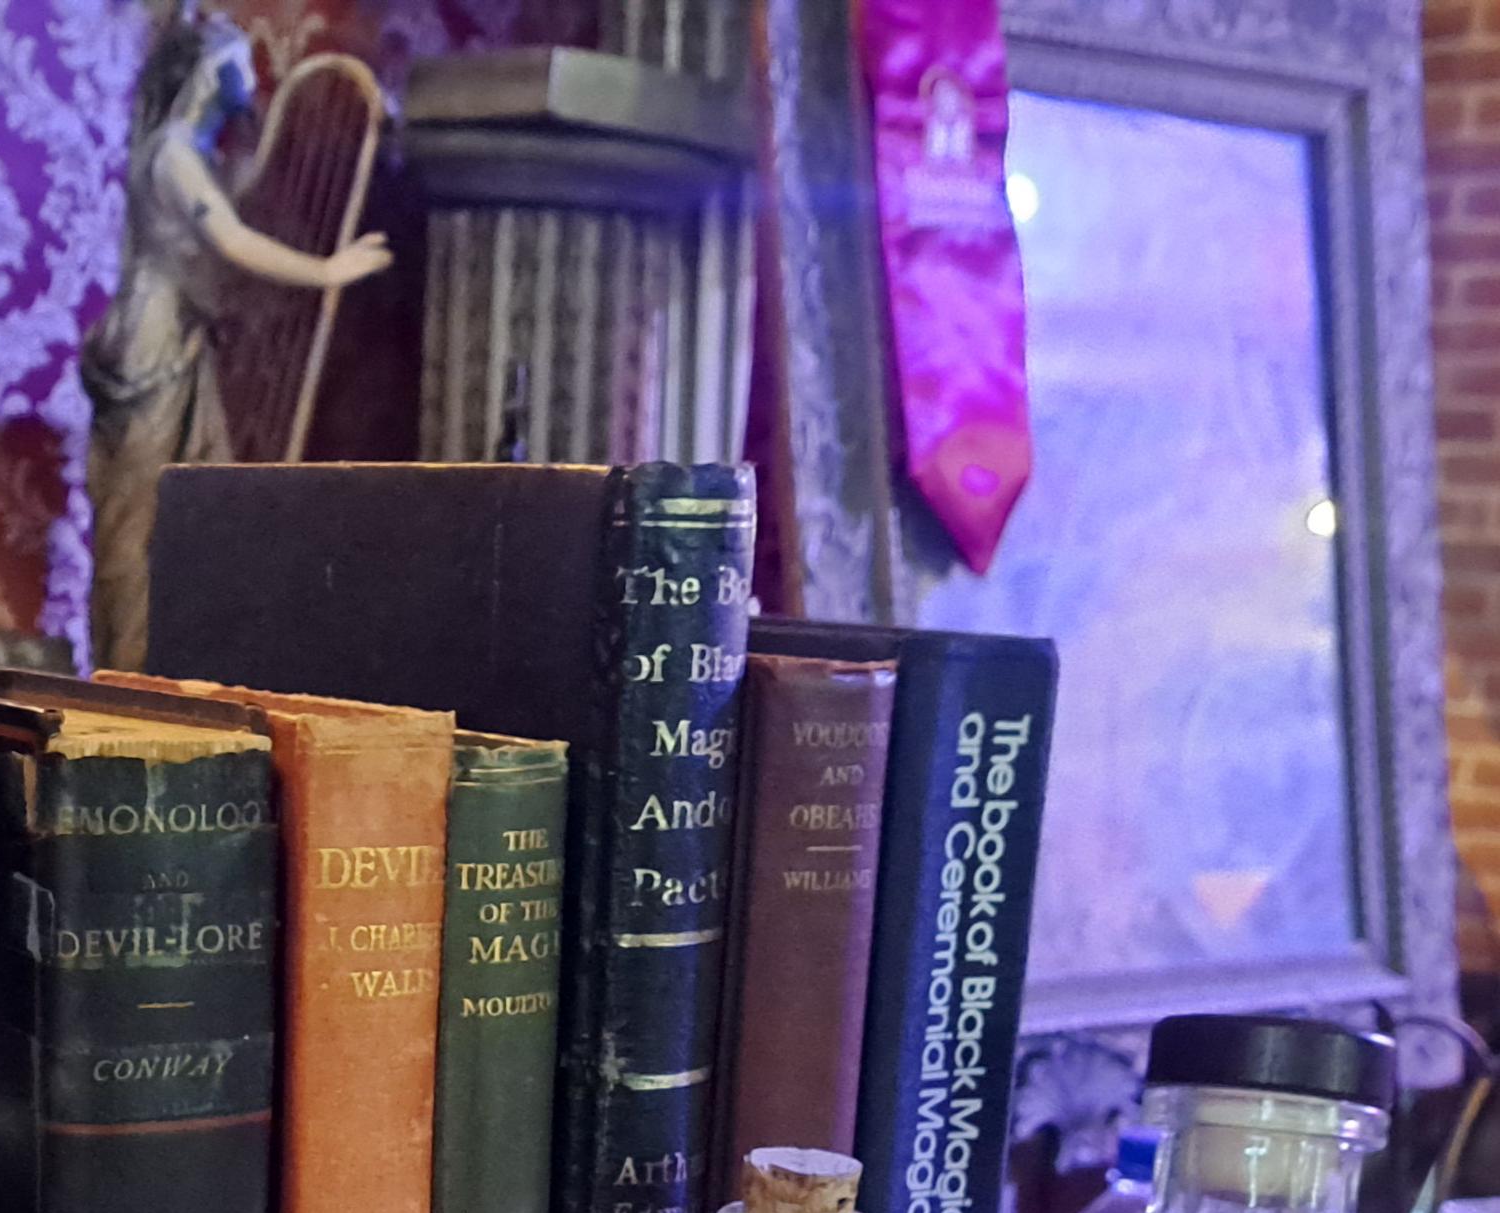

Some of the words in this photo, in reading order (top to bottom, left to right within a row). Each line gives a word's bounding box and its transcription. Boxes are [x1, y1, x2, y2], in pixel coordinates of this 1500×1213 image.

[616, 565, 701, 605] The
[631, 644, 672, 683] of
[949, 712, 989, 809] and
[986, 713, 1031, 793] The
[819, 764, 866, 787] AND
[630, 792, 716, 832] And
[503, 829, 549, 852] THE
[967, 800, 1018, 918] book
[142, 870, 190, 889] AND
[479, 902, 515, 925] OF
[56, 921, 264, 960] DEVIL-LORE
[919, 821, 976, 1081] Ceremonial
[963, 922, 999, 968] of
[949, 976, 997, 1090] Black
[93, 1045, 234, 1082] CONWAY
[613, 1151, 692, 1186] Arth
